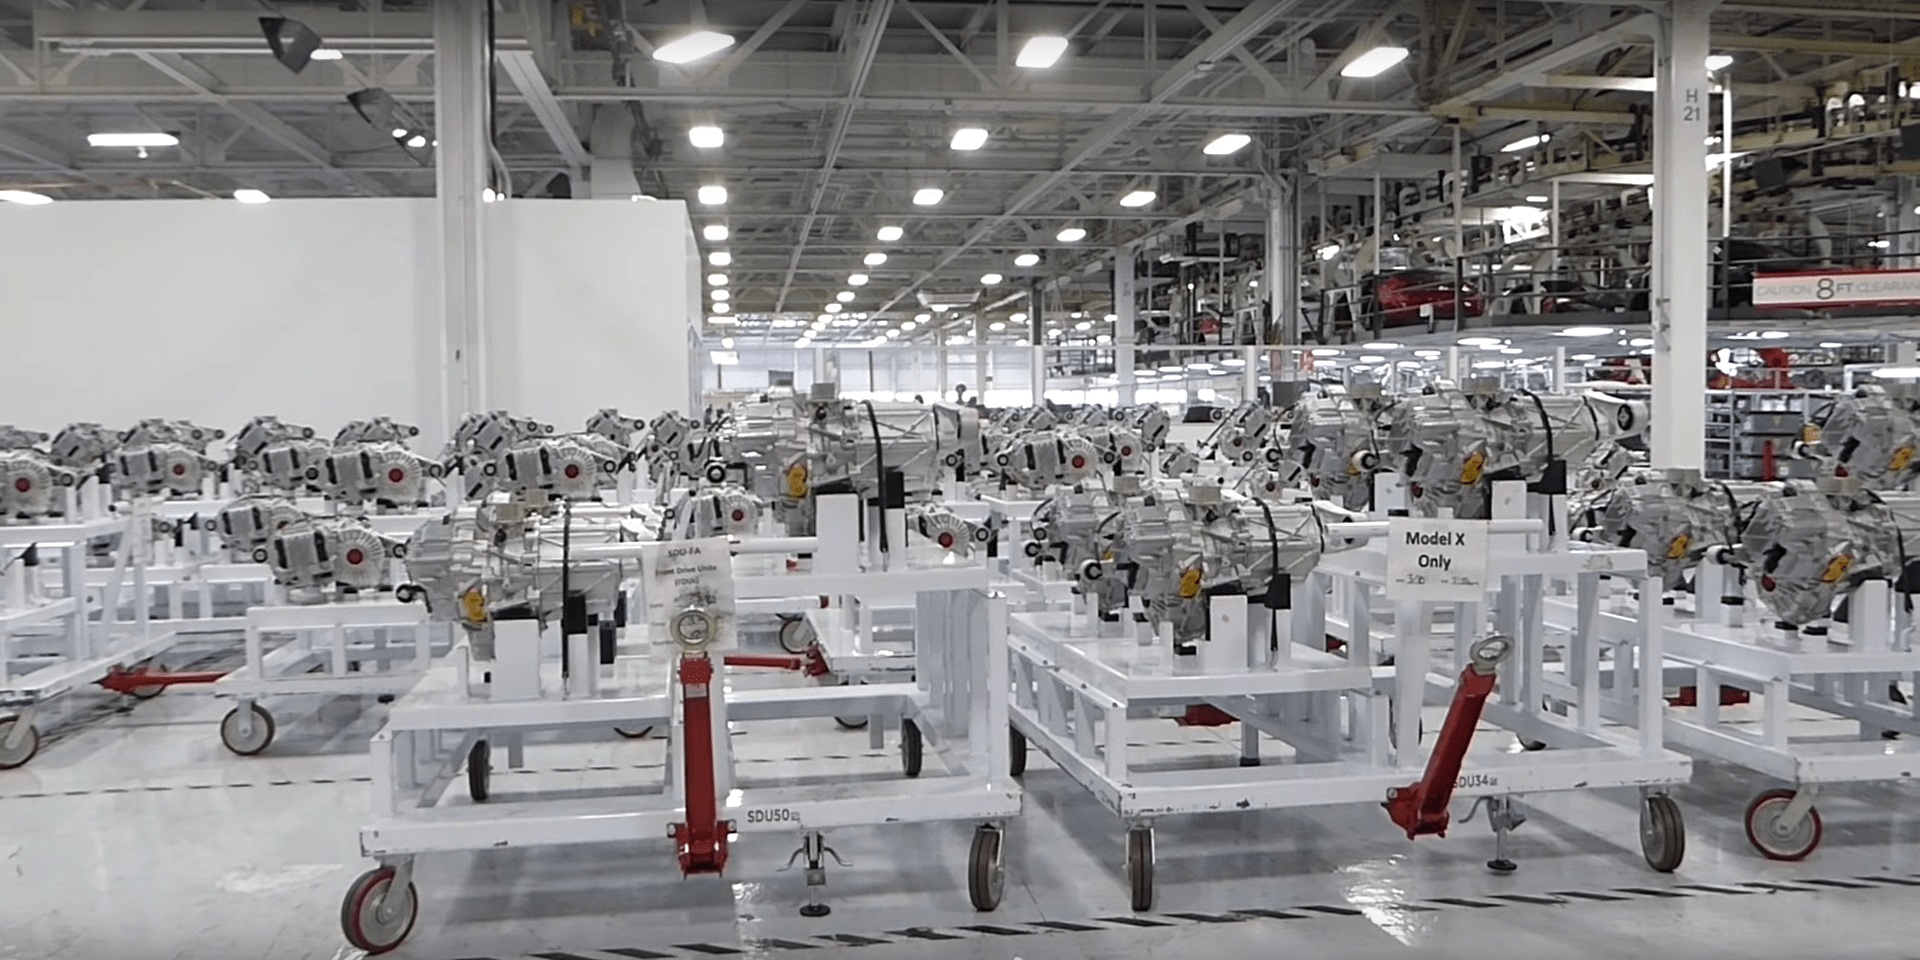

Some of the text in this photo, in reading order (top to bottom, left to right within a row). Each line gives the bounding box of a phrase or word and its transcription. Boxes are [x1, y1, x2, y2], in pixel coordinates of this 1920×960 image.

[1686, 88, 1699, 103] H
[1684, 106, 1700, 121] 21
[1756, 285, 1813, 296] CAUTION
[1816, 278, 1835, 300] 8
[1837, 282, 1854, 293] FT
[1406, 531, 1466, 546] Model X
[1418, 554, 1452, 572] Only
[747, 808, 790, 823] SDU50
